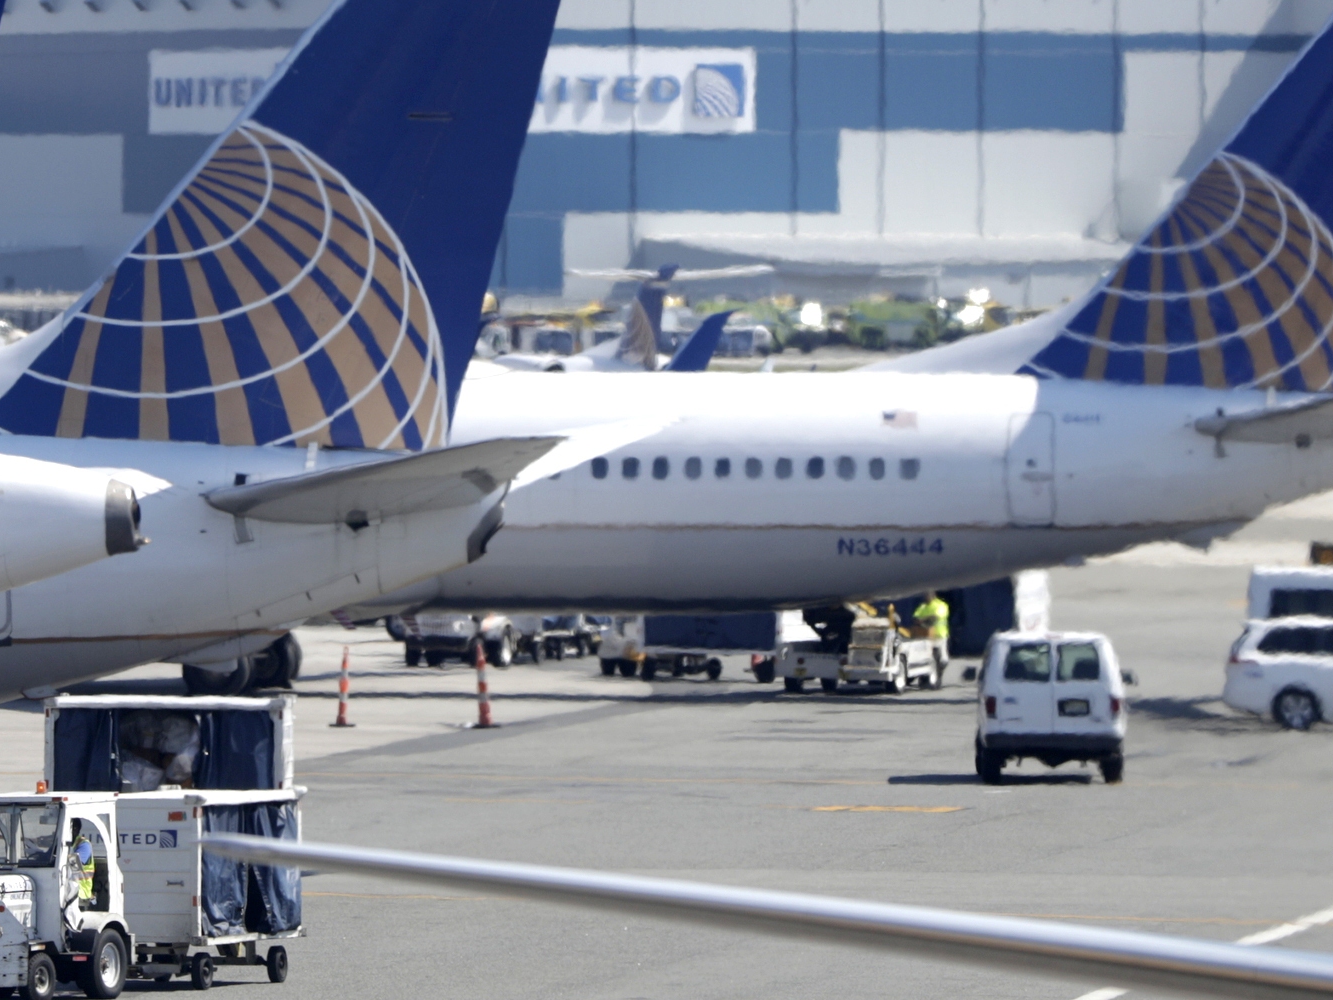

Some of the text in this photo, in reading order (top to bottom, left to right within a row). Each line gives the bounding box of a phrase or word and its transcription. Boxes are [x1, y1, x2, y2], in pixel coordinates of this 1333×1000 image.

[536, 75, 682, 105] ITED
[836, 537, 944, 557] N36444
[82, 833, 157, 845] NTED
